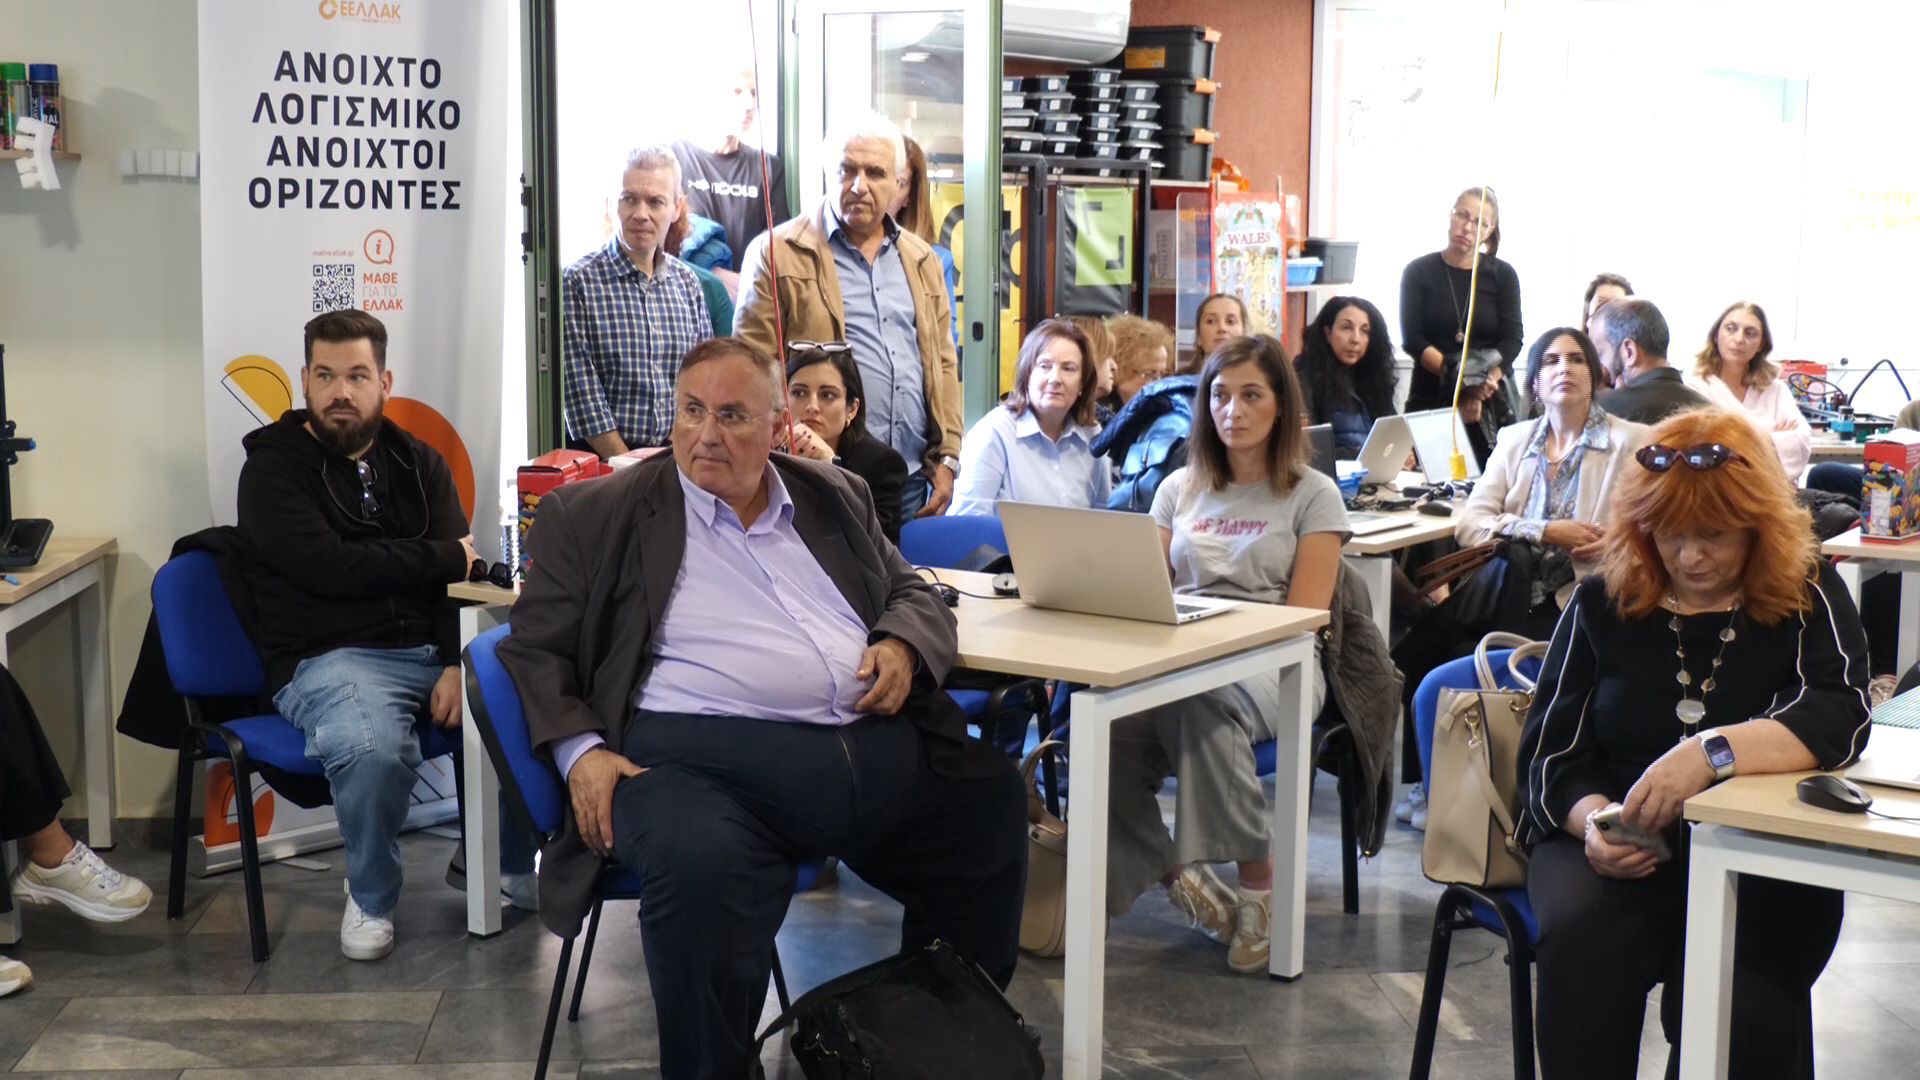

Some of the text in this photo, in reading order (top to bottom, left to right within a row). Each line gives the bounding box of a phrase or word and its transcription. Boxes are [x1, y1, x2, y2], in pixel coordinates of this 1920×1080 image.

[341, 0, 401, 20] ΕΕΛΛΑΚ
[274, 50, 441, 89] ΑΝΟΙΧΤΟ
[252, 92, 461, 130] ΛΟΓΙΣΜΙΚΟ
[266, 135, 446, 170] ΑΝΟΙΧΤΟΙ
[248, 177, 461, 210] ΟΡΙΖΟΝΤΕΣ
[1227, 231, 1271, 245] WALES
[363, 272, 398, 284] ΜΑΘΕ
[362, 286, 397, 297] ΓΙΑ ΤΟ
[363, 299, 403, 311] ΕΛΛΑΚ
[1215, 518, 1268, 535] HAPPY
